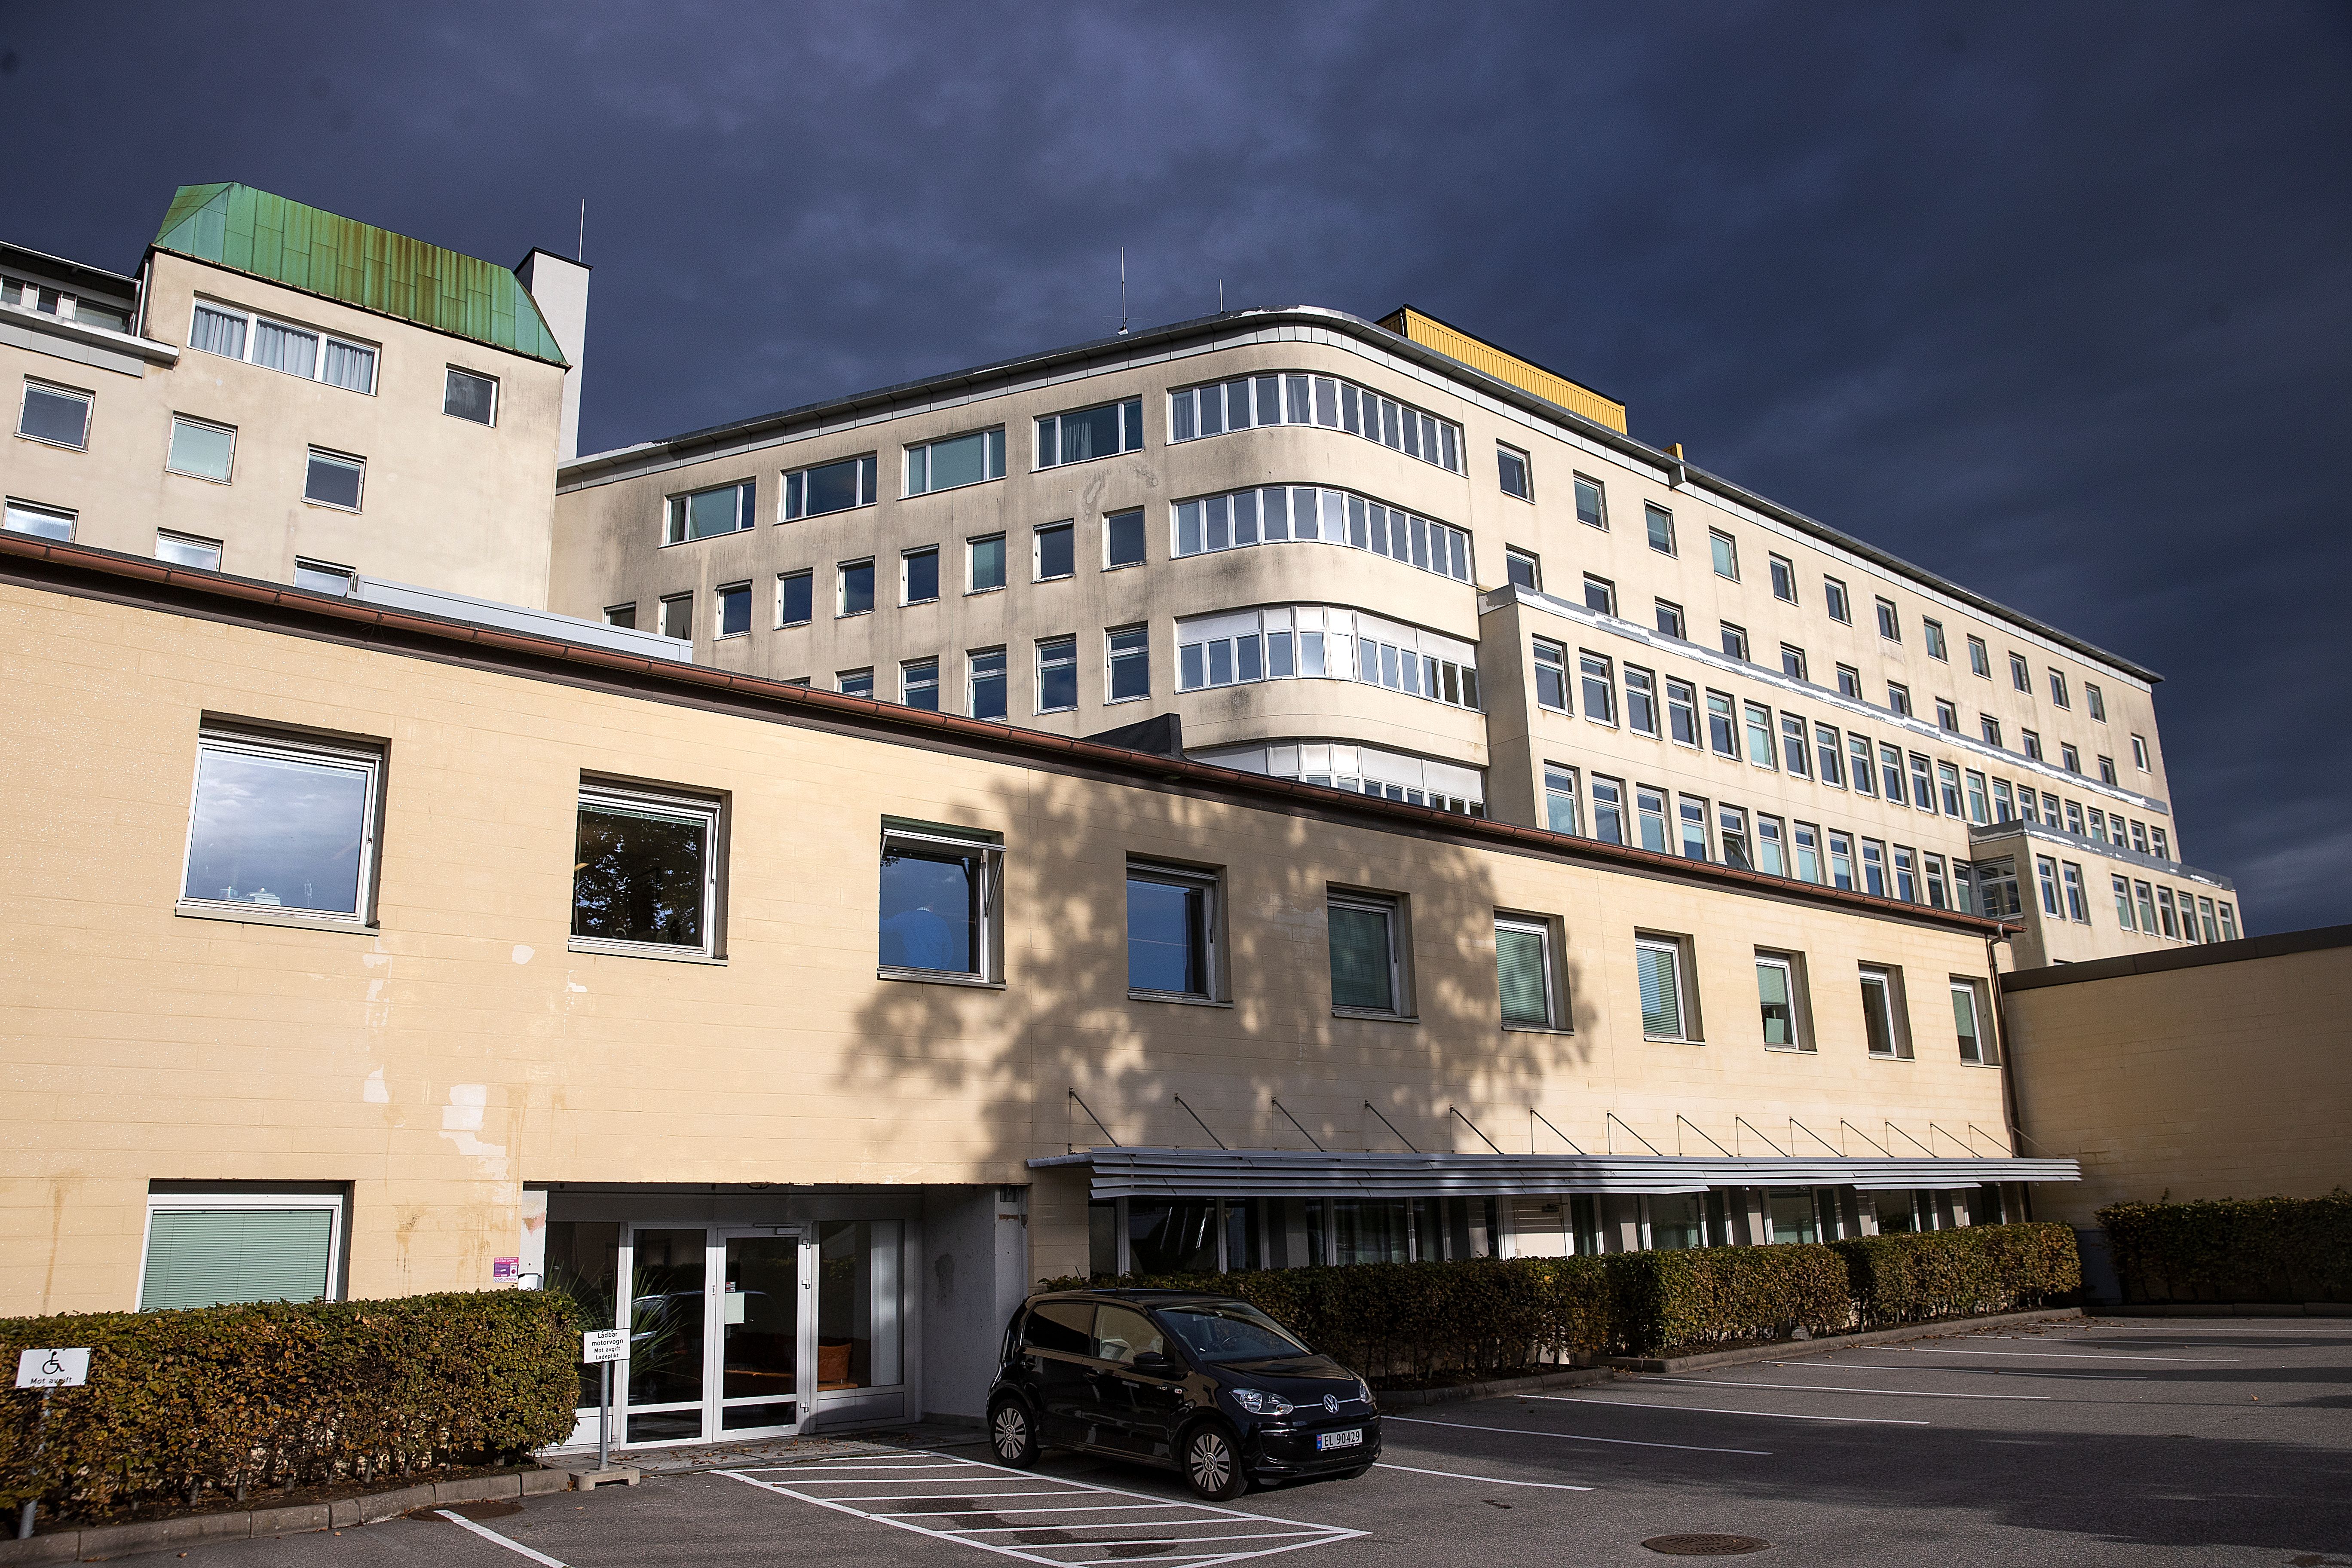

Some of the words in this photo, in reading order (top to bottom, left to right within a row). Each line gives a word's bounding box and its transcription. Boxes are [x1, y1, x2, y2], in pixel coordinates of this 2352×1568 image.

[49, 1376, 73, 1384] avft
[1324, 1435, 1333, 1446] EL
[1336, 1430, 1360, 1445] 90429
